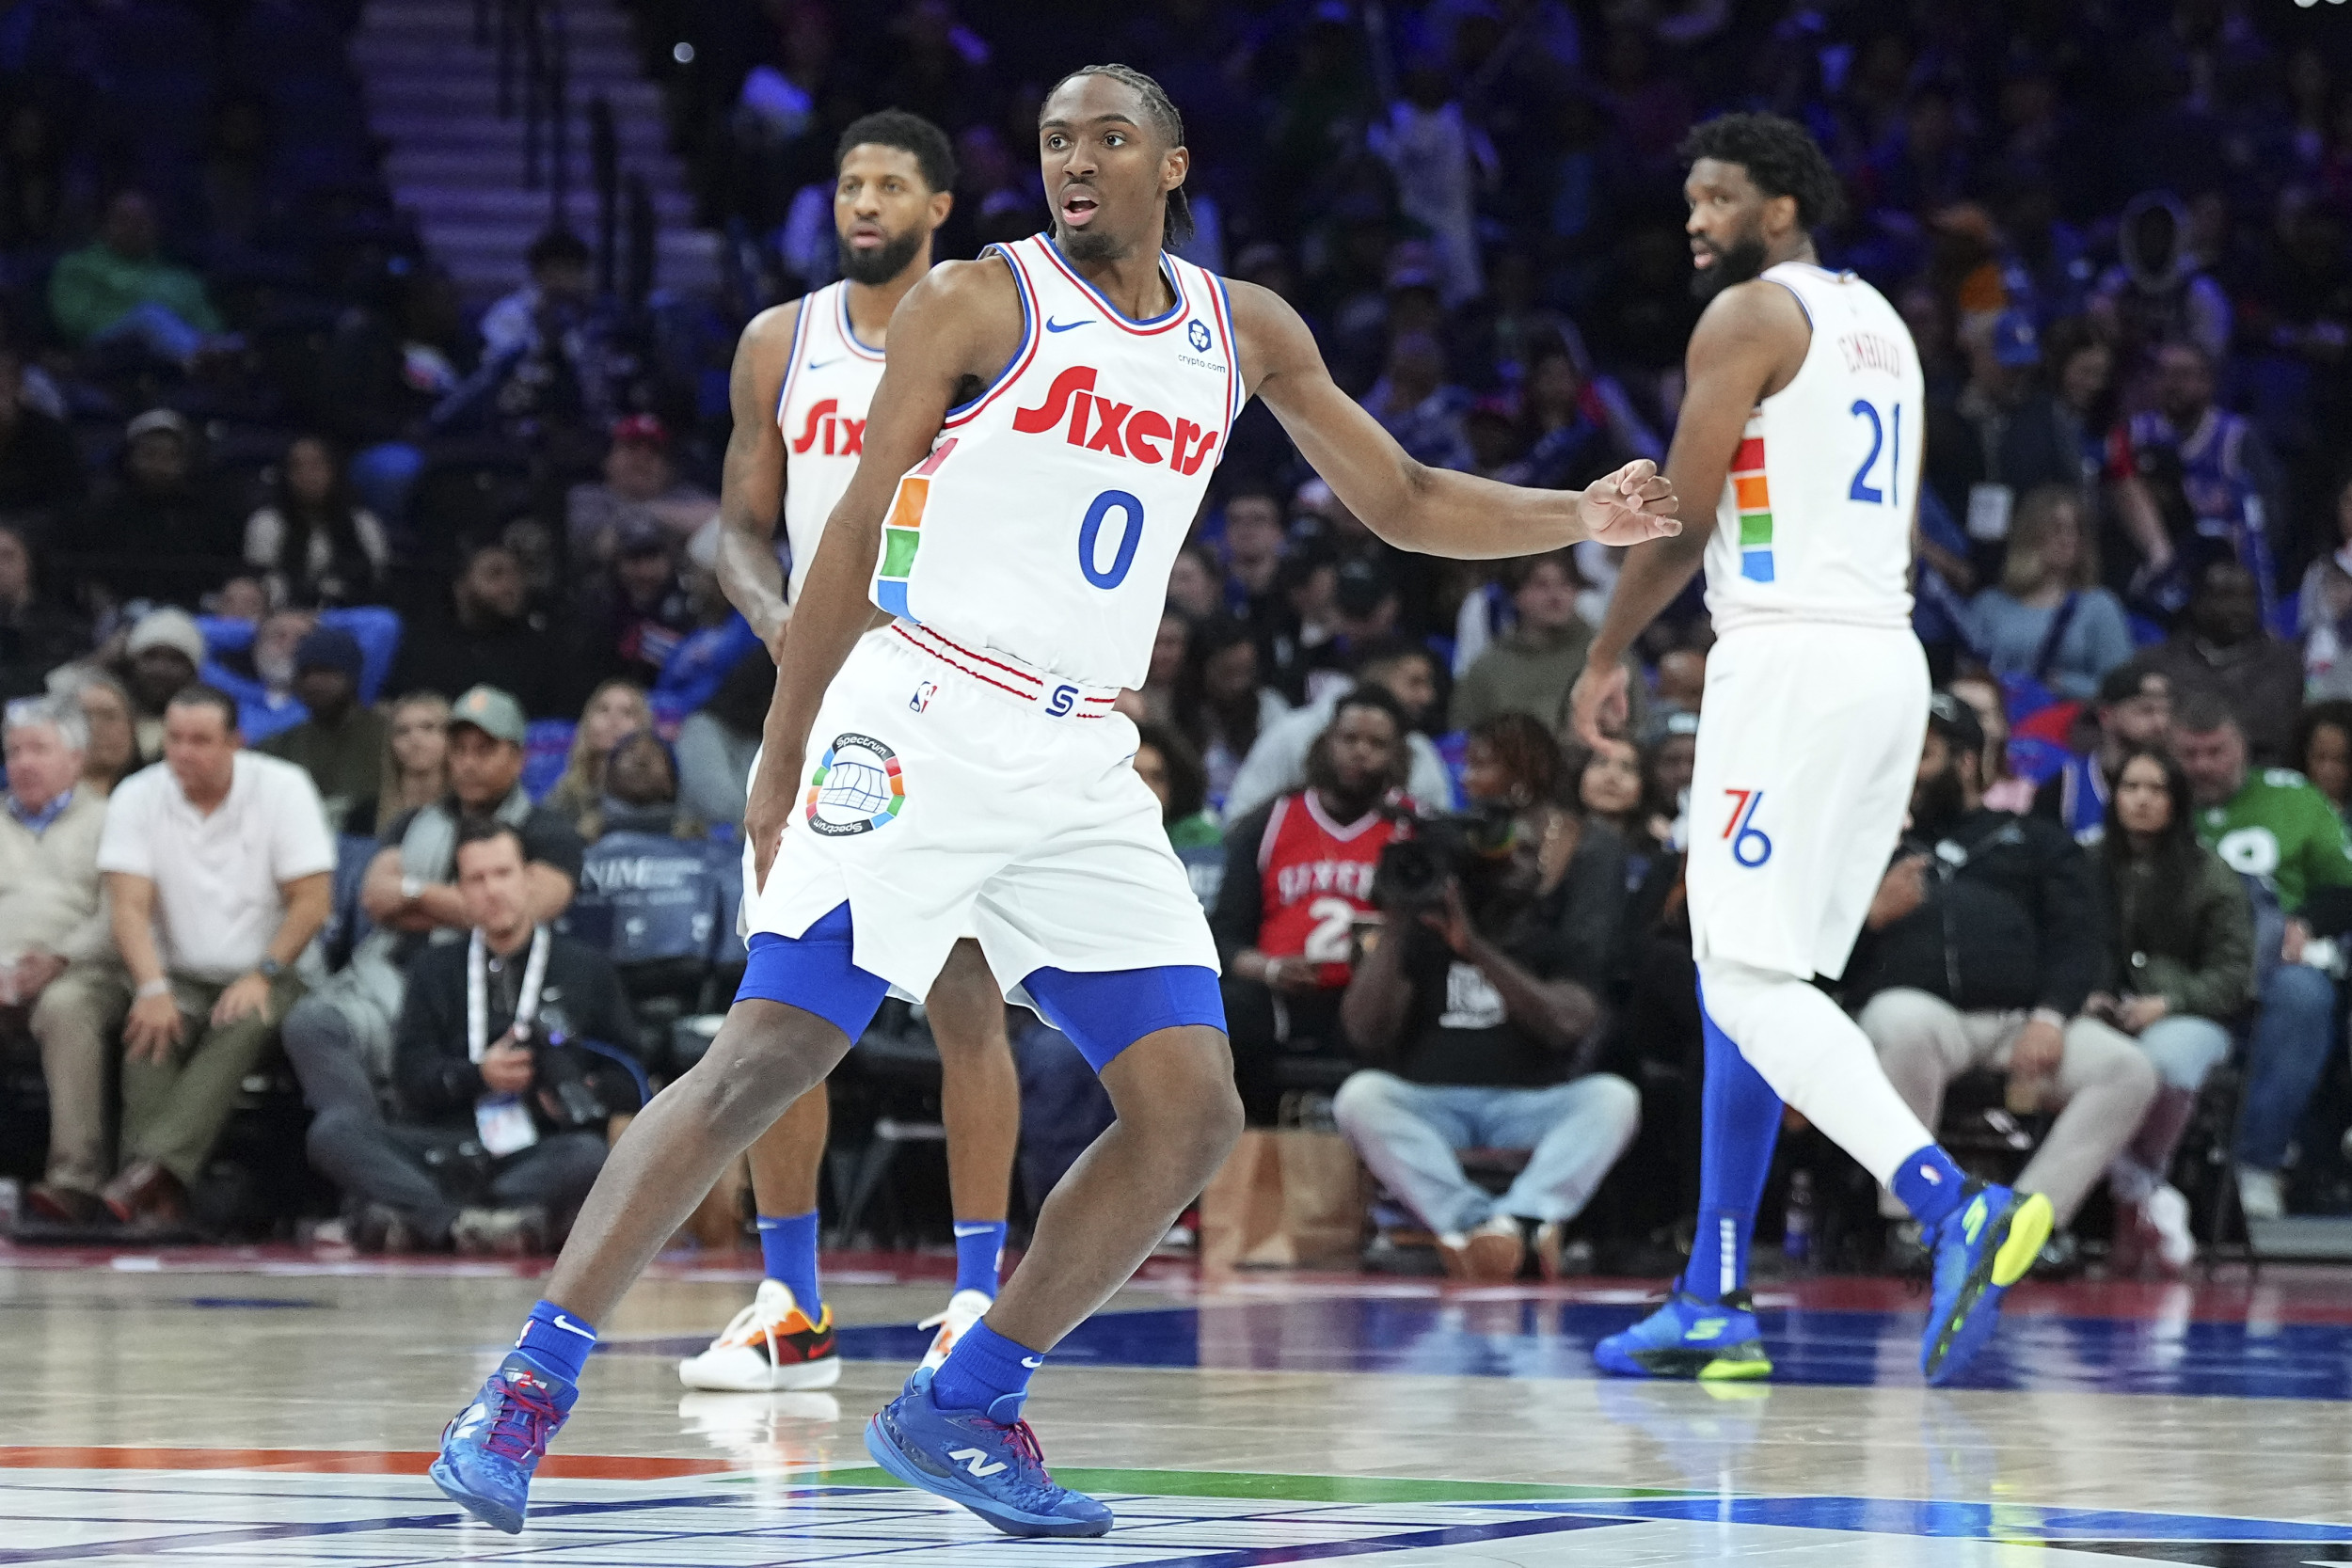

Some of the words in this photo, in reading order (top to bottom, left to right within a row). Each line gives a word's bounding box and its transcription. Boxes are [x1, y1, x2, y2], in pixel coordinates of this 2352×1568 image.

[1178, 354, 1226, 373] crypto.com
[793, 399, 867, 455] Six
[1012, 365, 1219, 476] Sixers
[1850, 399, 1900, 508] 21
[1078, 489, 1144, 590] 0
[835, 736, 888, 756] Spectrum
[813, 817, 864, 834] Spectrum
[1723, 789, 1772, 867] 76
[948, 1448, 1009, 1478] N
